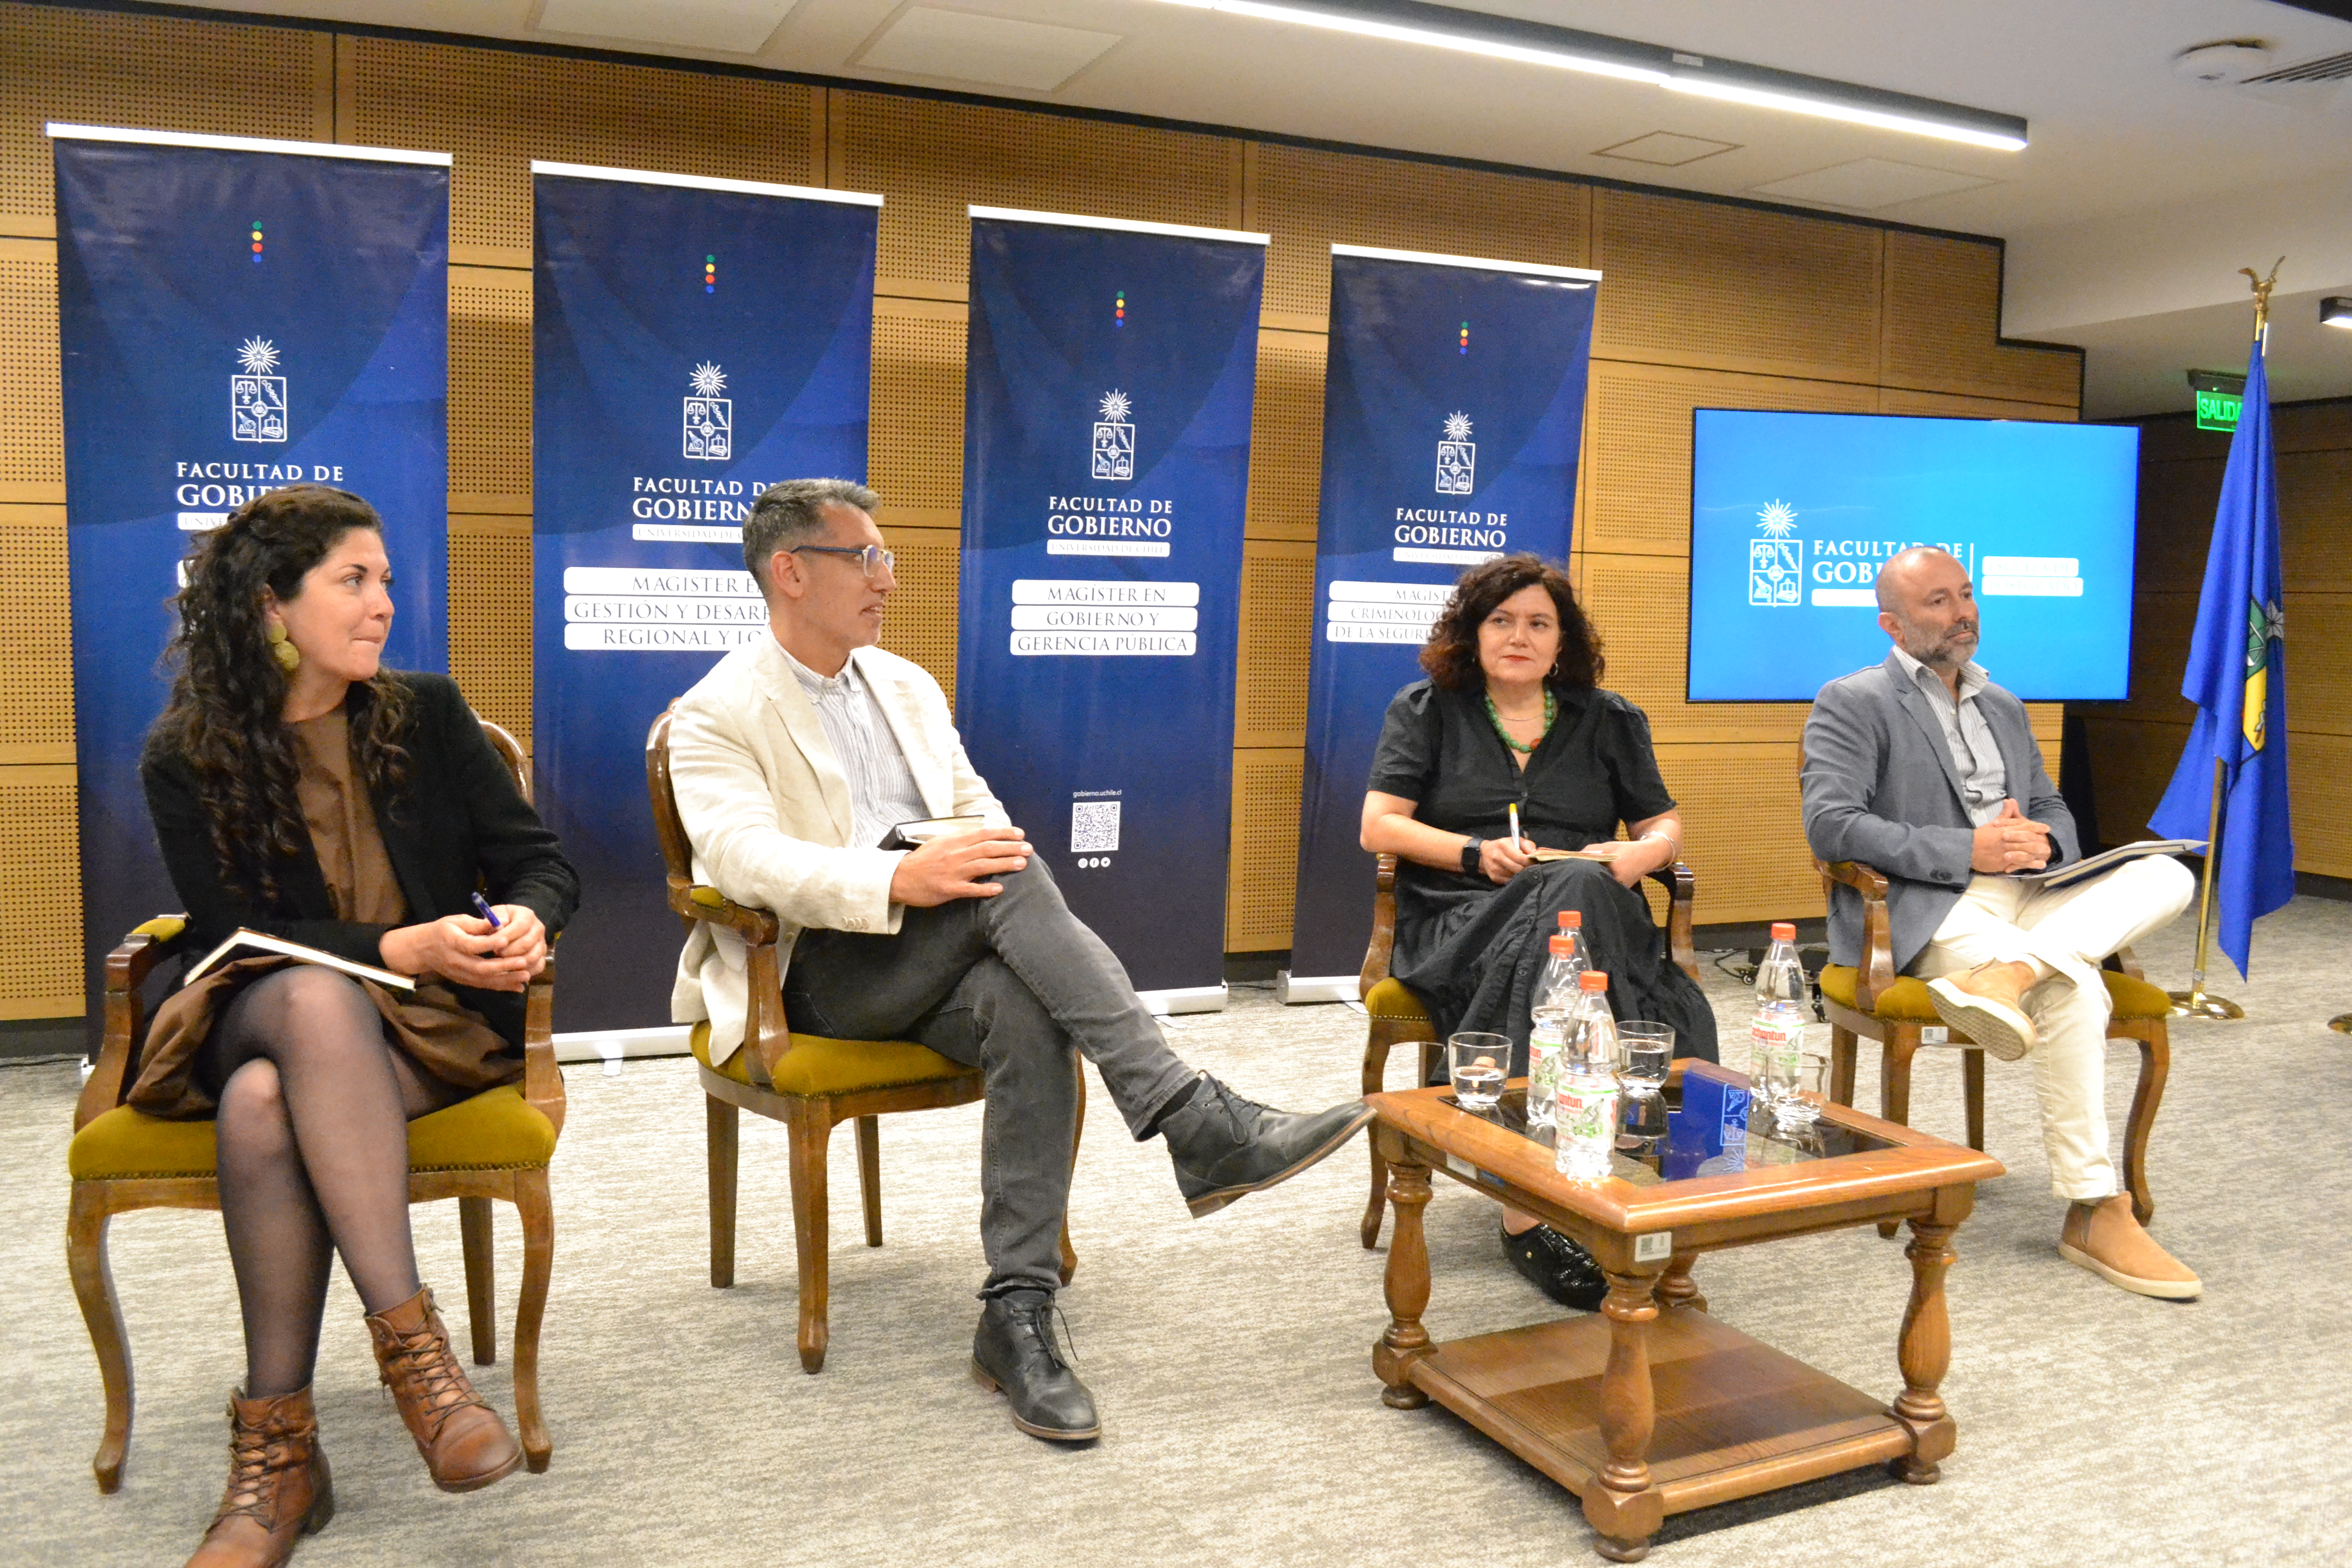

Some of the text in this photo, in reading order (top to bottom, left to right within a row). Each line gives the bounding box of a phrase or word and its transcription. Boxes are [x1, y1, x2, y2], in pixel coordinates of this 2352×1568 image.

[177, 462, 343, 481] FACULTAD DE
[177, 484, 287, 506] GOBI
[633, 477, 777, 496] FACULTAD D
[1049, 497, 1172, 513] FACULTAD DE
[1048, 515, 1171, 537] GOBIERNO
[1396, 508, 1507, 526] FACULTAD DE
[639, 528, 716, 539] UNIVERSIDAD
[721, 531, 732, 540] DE
[1394, 525, 1506, 547] GOBIERNO
[1051, 544, 1118, 553] UNIVERSIDAD
[633, 574, 738, 592] MAGÍSTER
[1048, 584, 1166, 602] MAGÍSTER EN
[574, 600, 668, 619] GESTIÓN
[676, 604, 688, 619] Y
[1047, 611, 1160, 626] GOBIERNO Y
[604, 629, 712, 645] REGIONAL
[719, 630, 730, 645] Y
[1335, 626, 1353, 638] DE
[1359, 627, 1374, 638] LA
[1018, 634, 1187, 651] GERENCIA PÚBLICA
[1073, 789, 1122, 798] gobierno.uchile.cl
